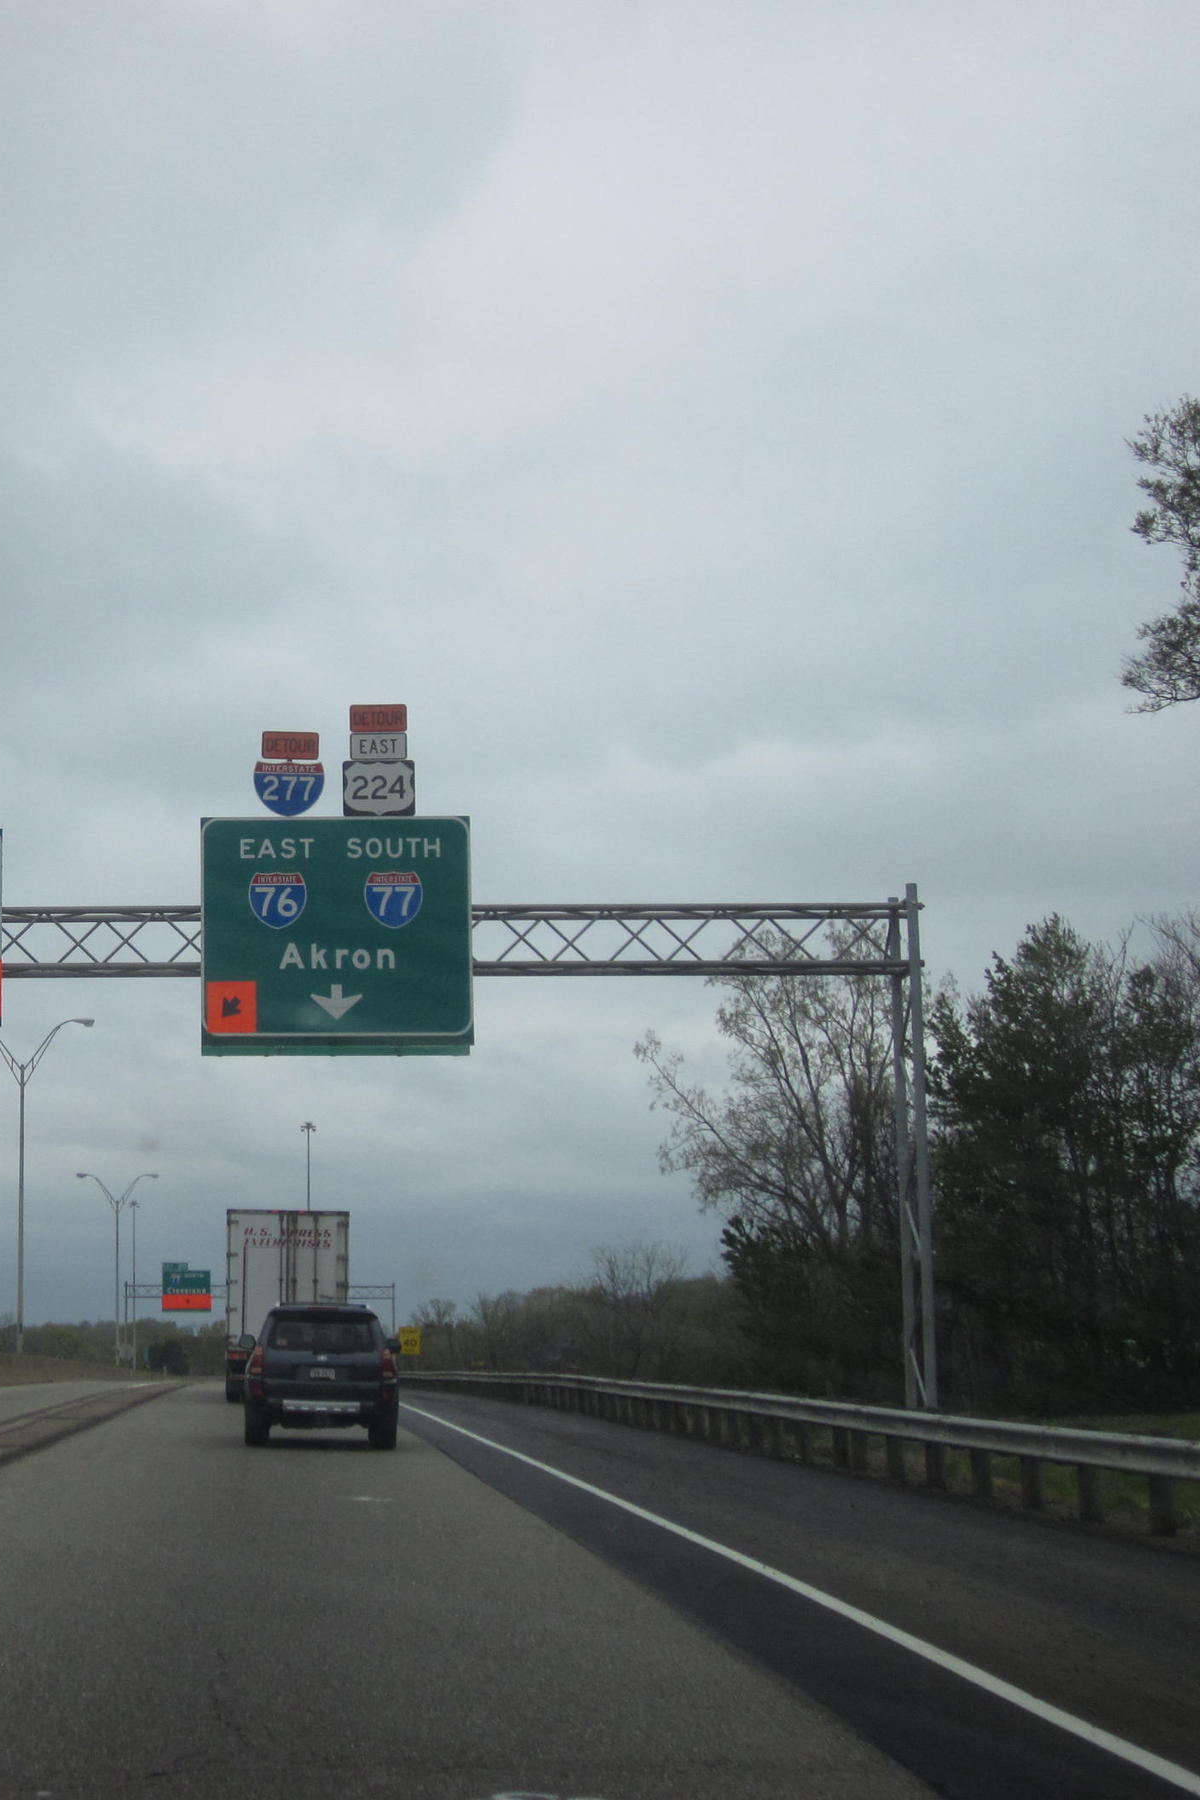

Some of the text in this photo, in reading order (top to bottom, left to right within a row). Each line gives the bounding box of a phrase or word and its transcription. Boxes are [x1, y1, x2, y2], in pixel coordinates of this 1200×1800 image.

[353, 711, 404, 726] DETOUR
[265, 738, 316, 753] DETOUR
[359, 738, 397, 754] EAST
[262, 764, 317, 773] INTERSTATE
[263, 775, 315, 801] 277
[352, 775, 406, 800] 224
[240, 838, 314, 859] EAST
[346, 838, 441, 859] SOUTH
[257, 875, 297, 884] INTERSTATE
[373, 875, 412, 884] INTERSTATE
[255, 887, 298, 918] 76
[372, 886, 415, 917] 77
[279, 942, 396, 969] Akron
